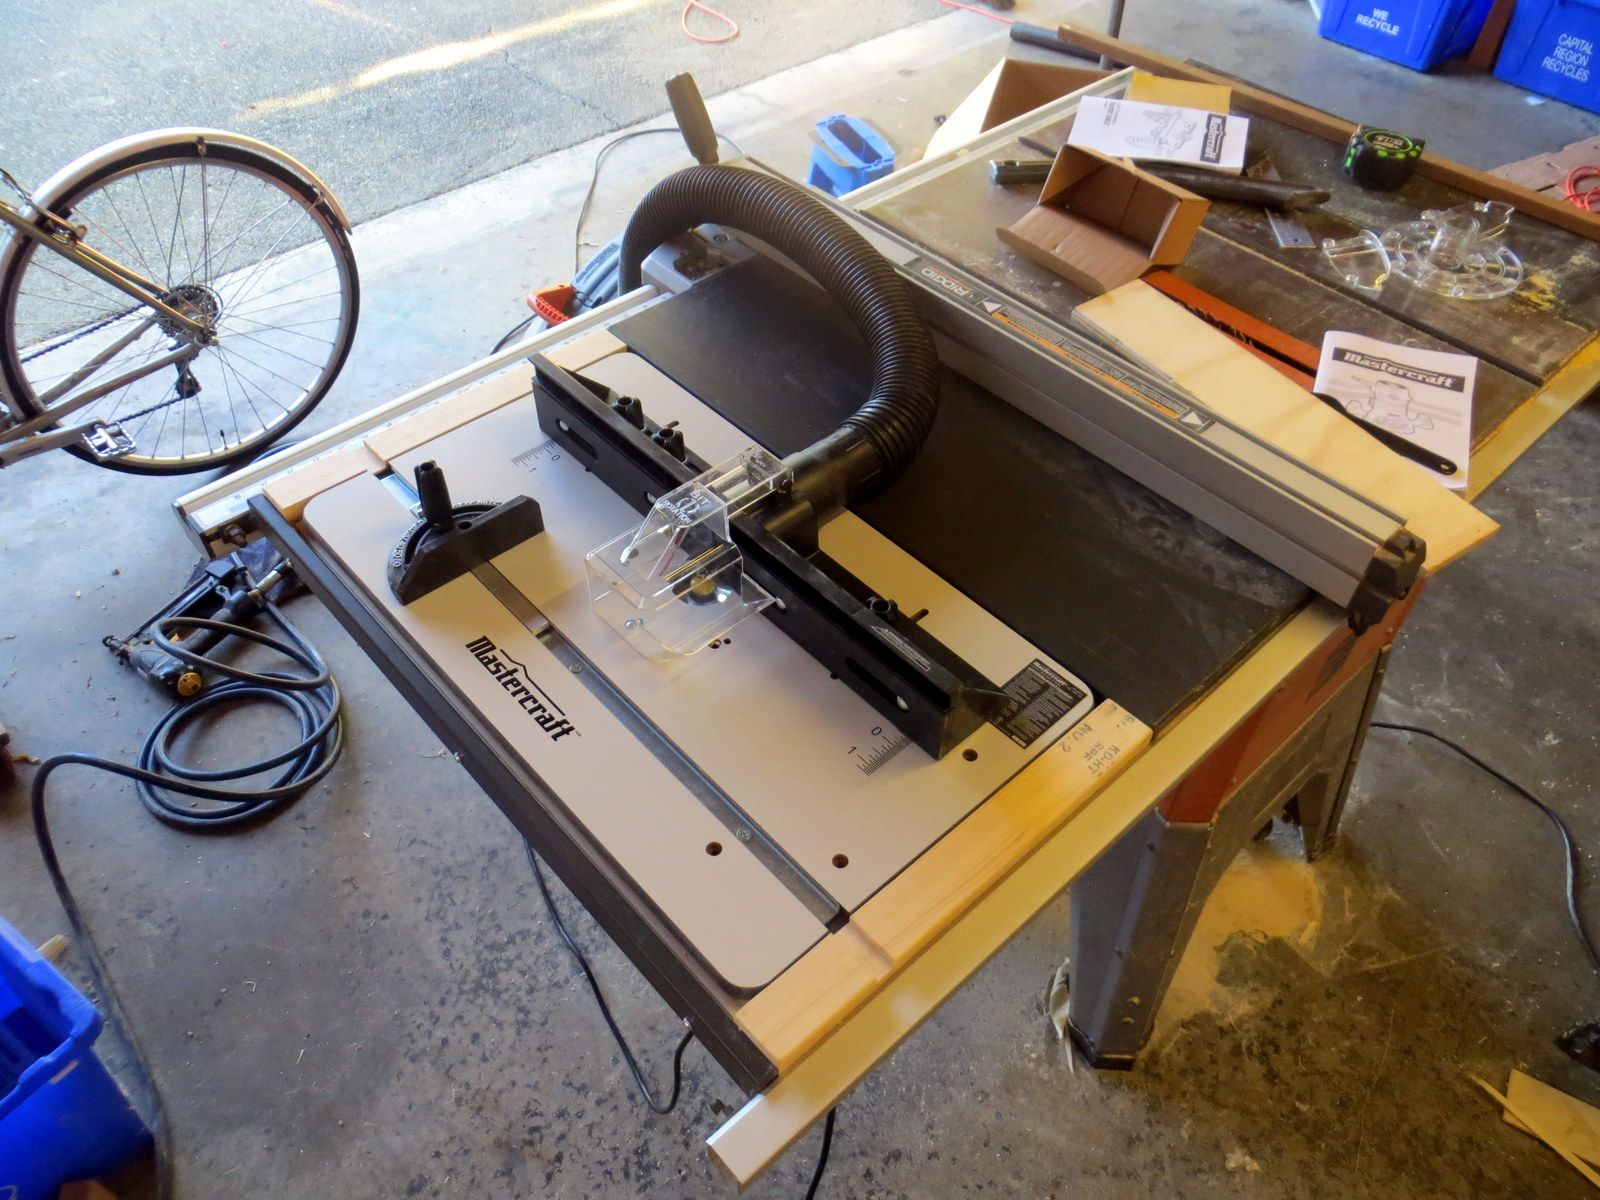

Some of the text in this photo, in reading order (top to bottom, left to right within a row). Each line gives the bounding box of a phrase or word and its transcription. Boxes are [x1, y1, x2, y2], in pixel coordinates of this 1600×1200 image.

[1372, 7, 1389, 21] WE
[1356, 14, 1399, 36] RECYCLE
[1558, 33, 1594, 54] CAPITAL
[1553, 46, 1590, 67] REGION
[1542, 56, 1590, 82] RECYCLES
[921, 268, 970, 296] RIDGID
[1343, 351, 1455, 387] Mastercraft
[465, 635, 576, 742] Mastercraft
[871, 726, 883, 736] 0
[848, 746, 858, 755] 1
